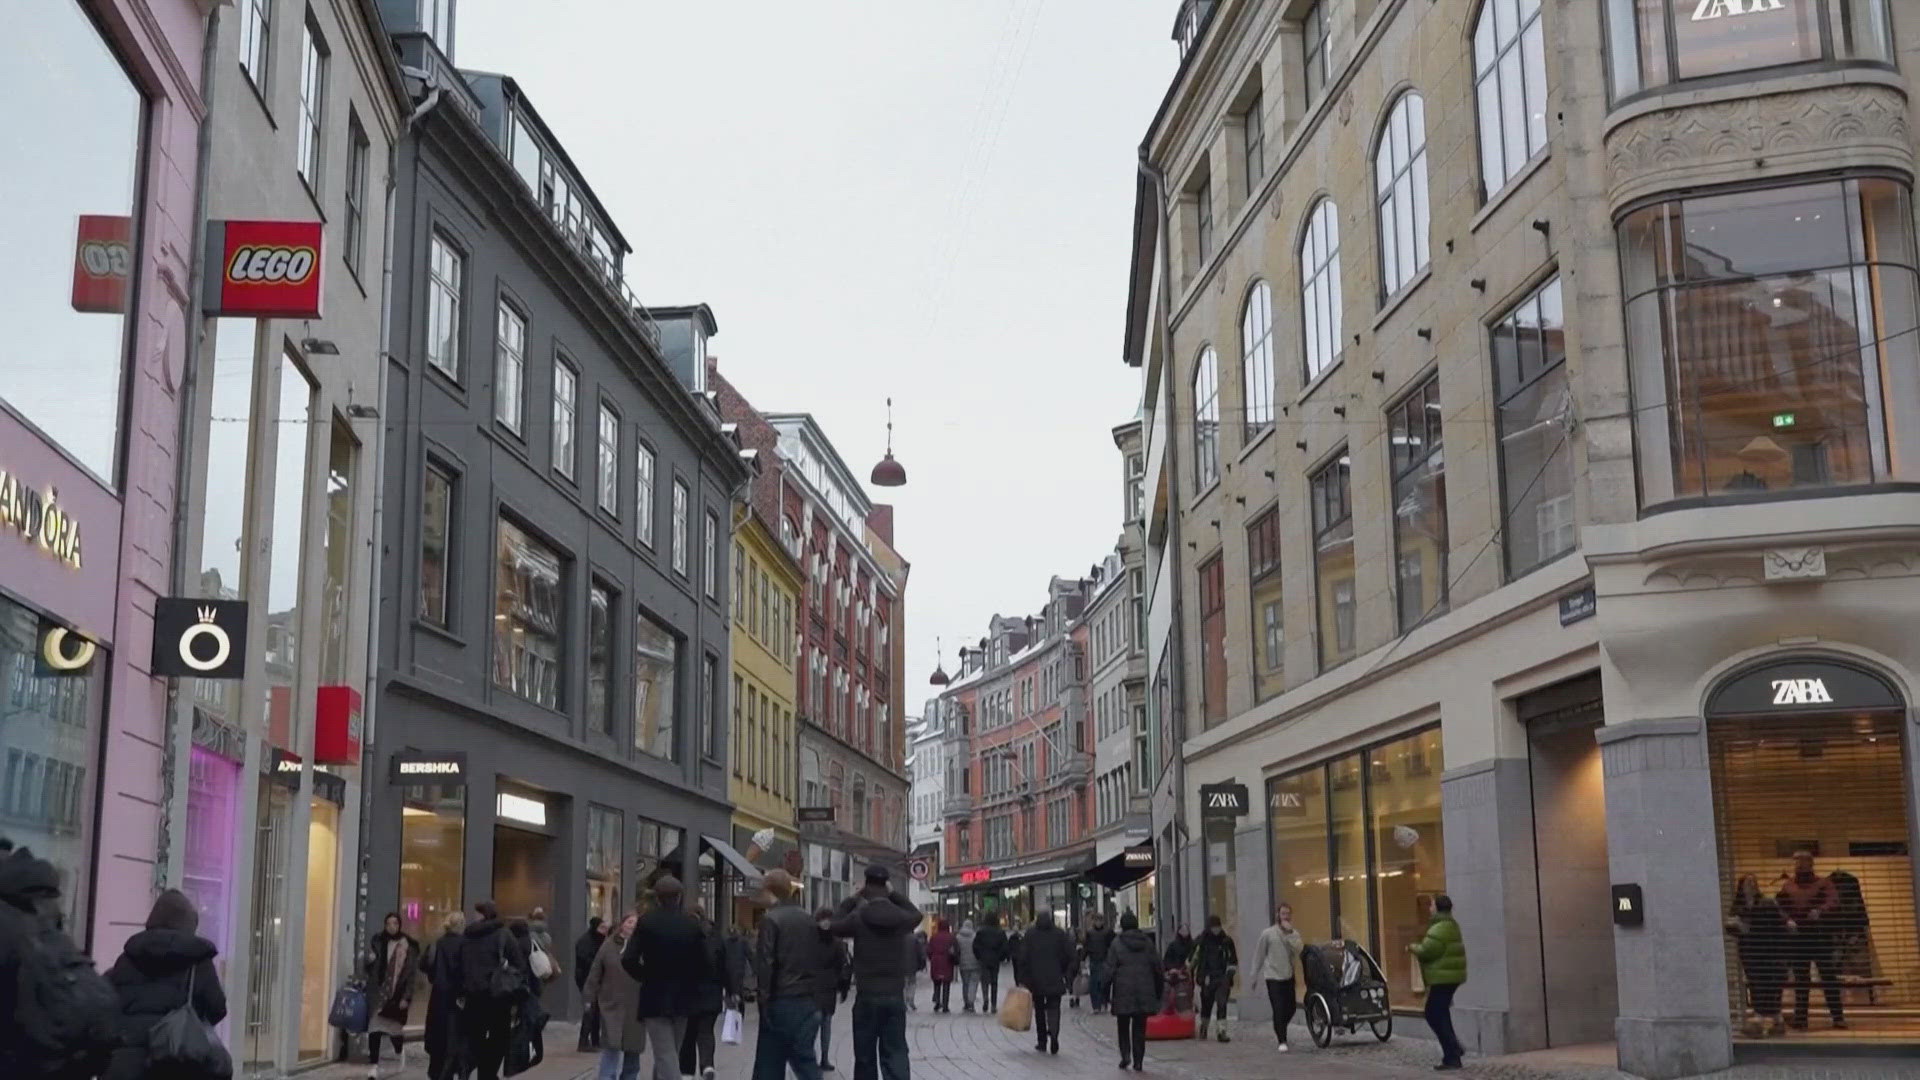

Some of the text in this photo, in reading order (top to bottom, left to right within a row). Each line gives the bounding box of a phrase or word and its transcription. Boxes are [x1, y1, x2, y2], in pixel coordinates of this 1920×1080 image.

[228, 246, 314, 283] LEGO
[1771, 678, 1834, 704] ZARA
[400, 762, 460, 774] BERSHKA
[1208, 792, 1239, 808] ZARA
